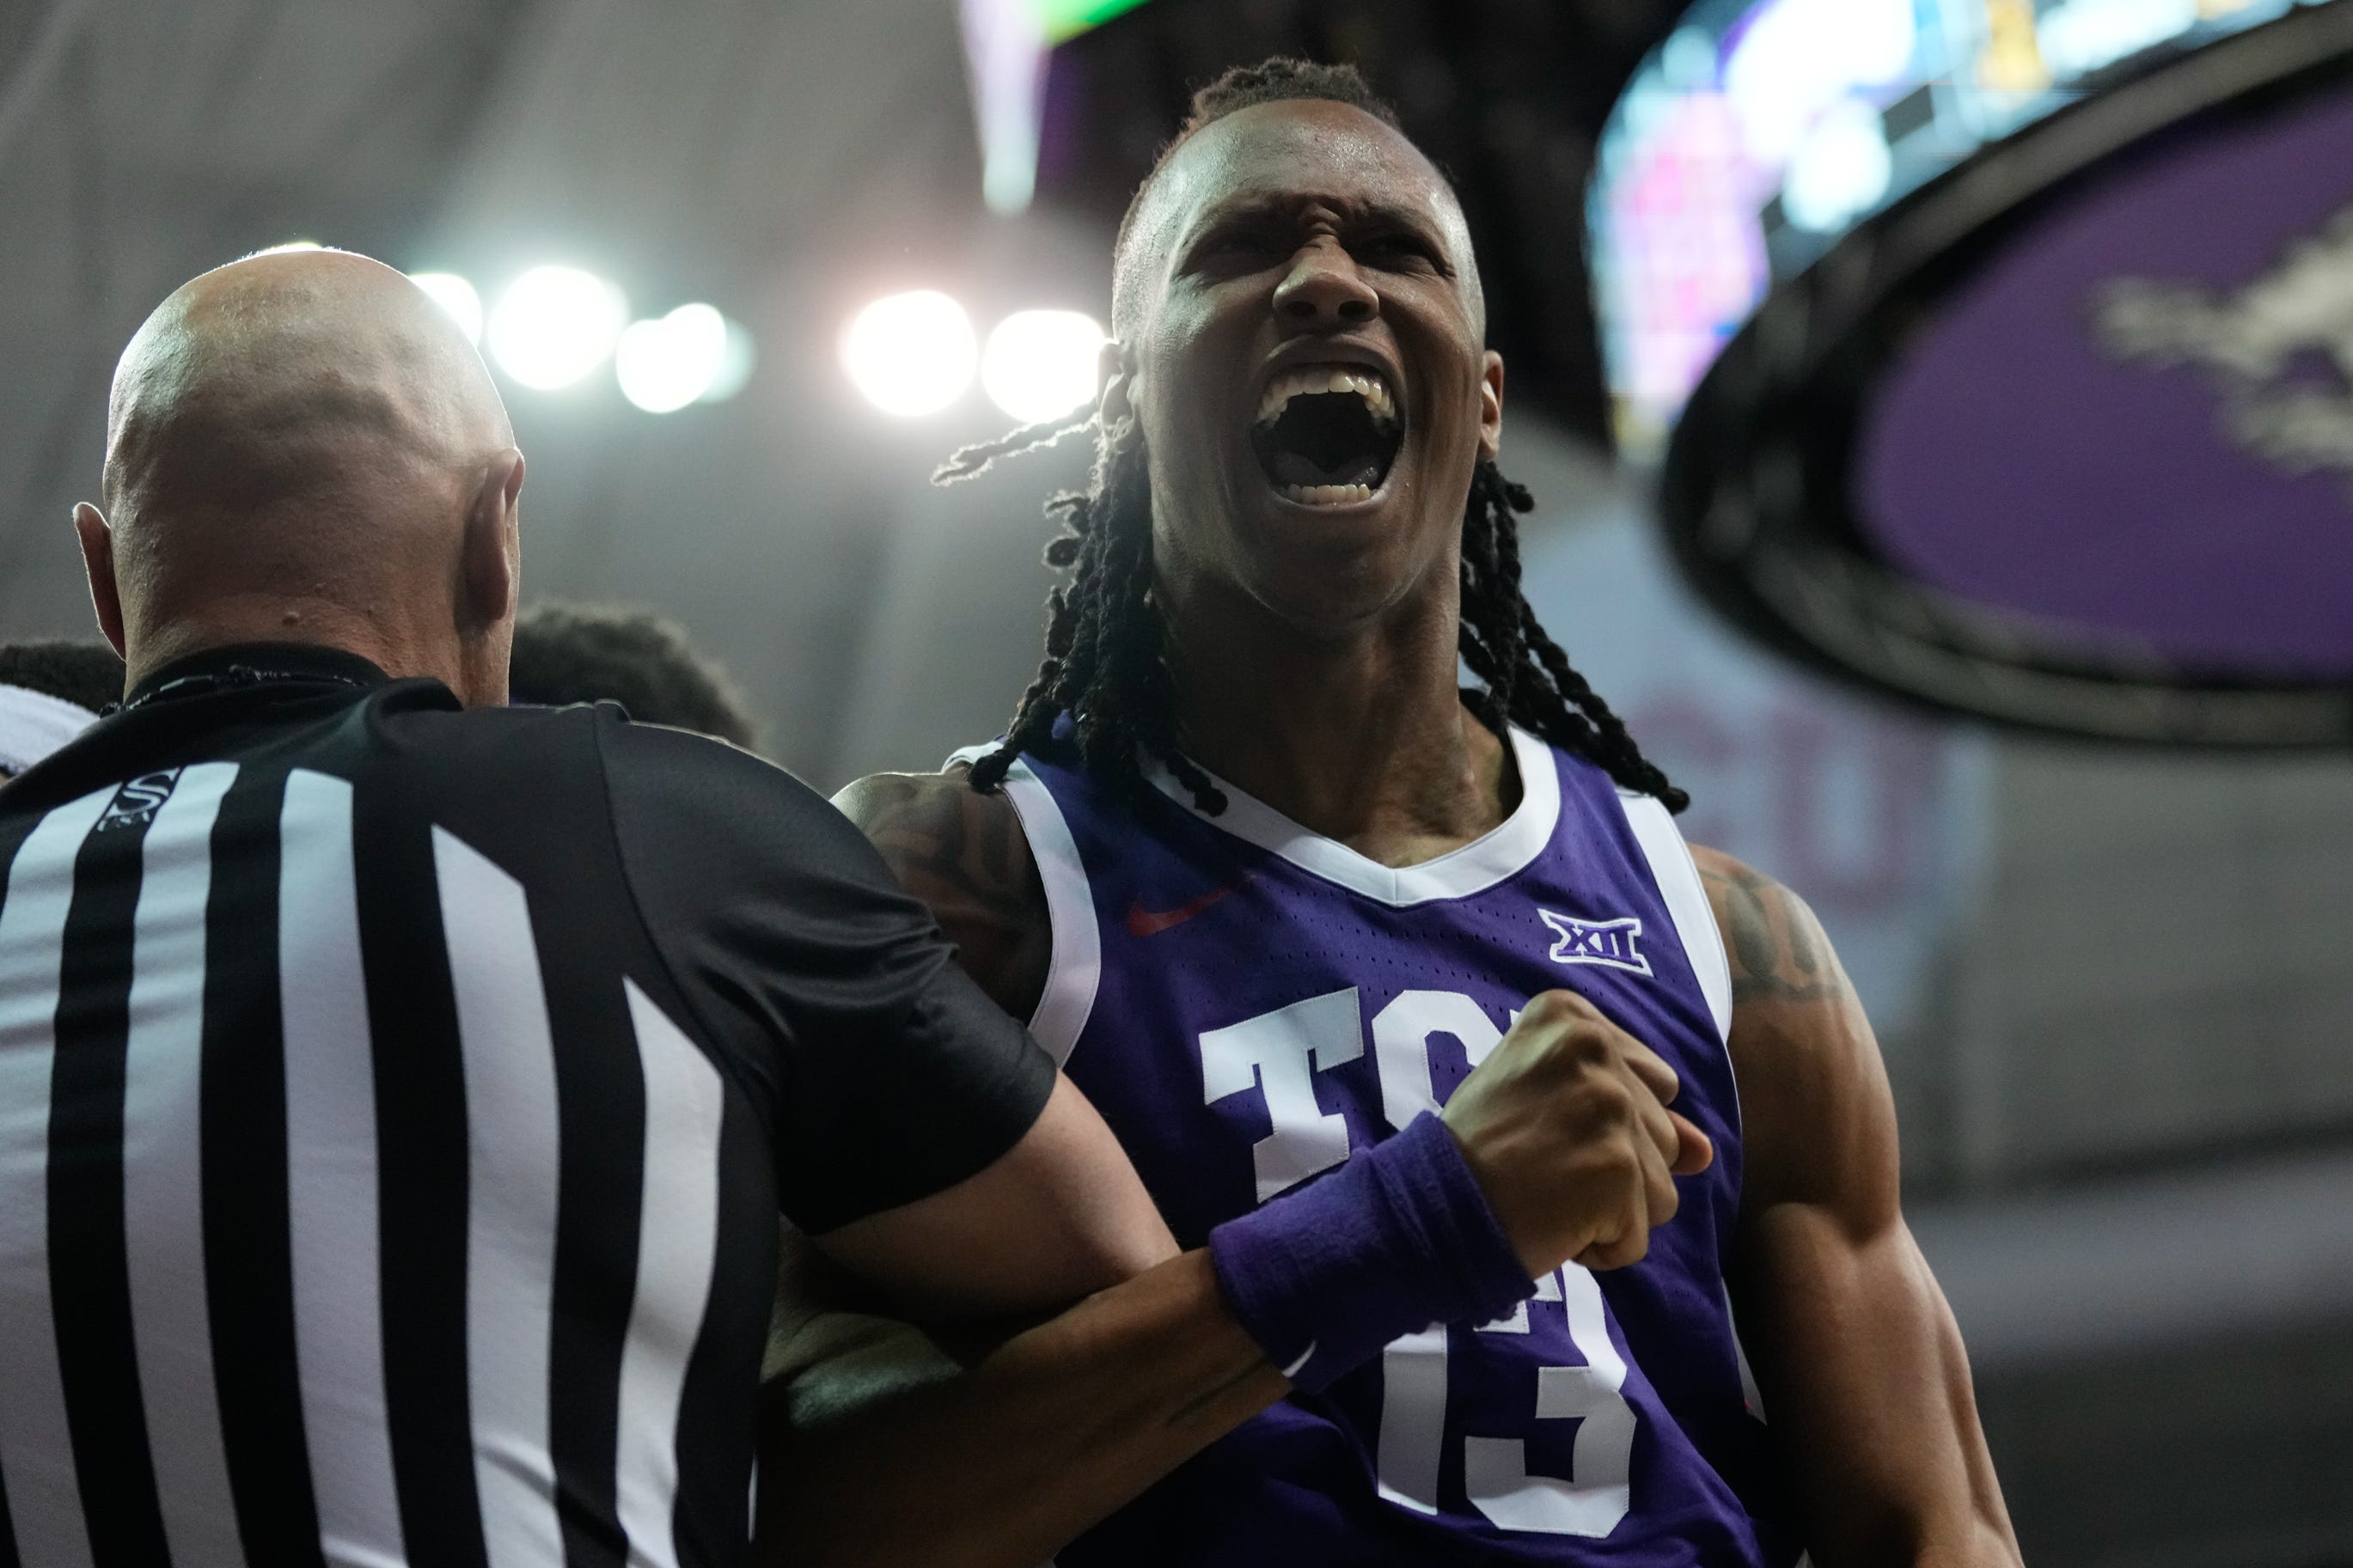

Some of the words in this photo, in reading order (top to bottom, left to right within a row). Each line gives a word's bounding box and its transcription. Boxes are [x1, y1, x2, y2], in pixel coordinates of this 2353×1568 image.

[1537, 908, 1654, 978] XII
[1198, 985, 1520, 1204] TC
[1378, 1259, 1637, 1539] 13
